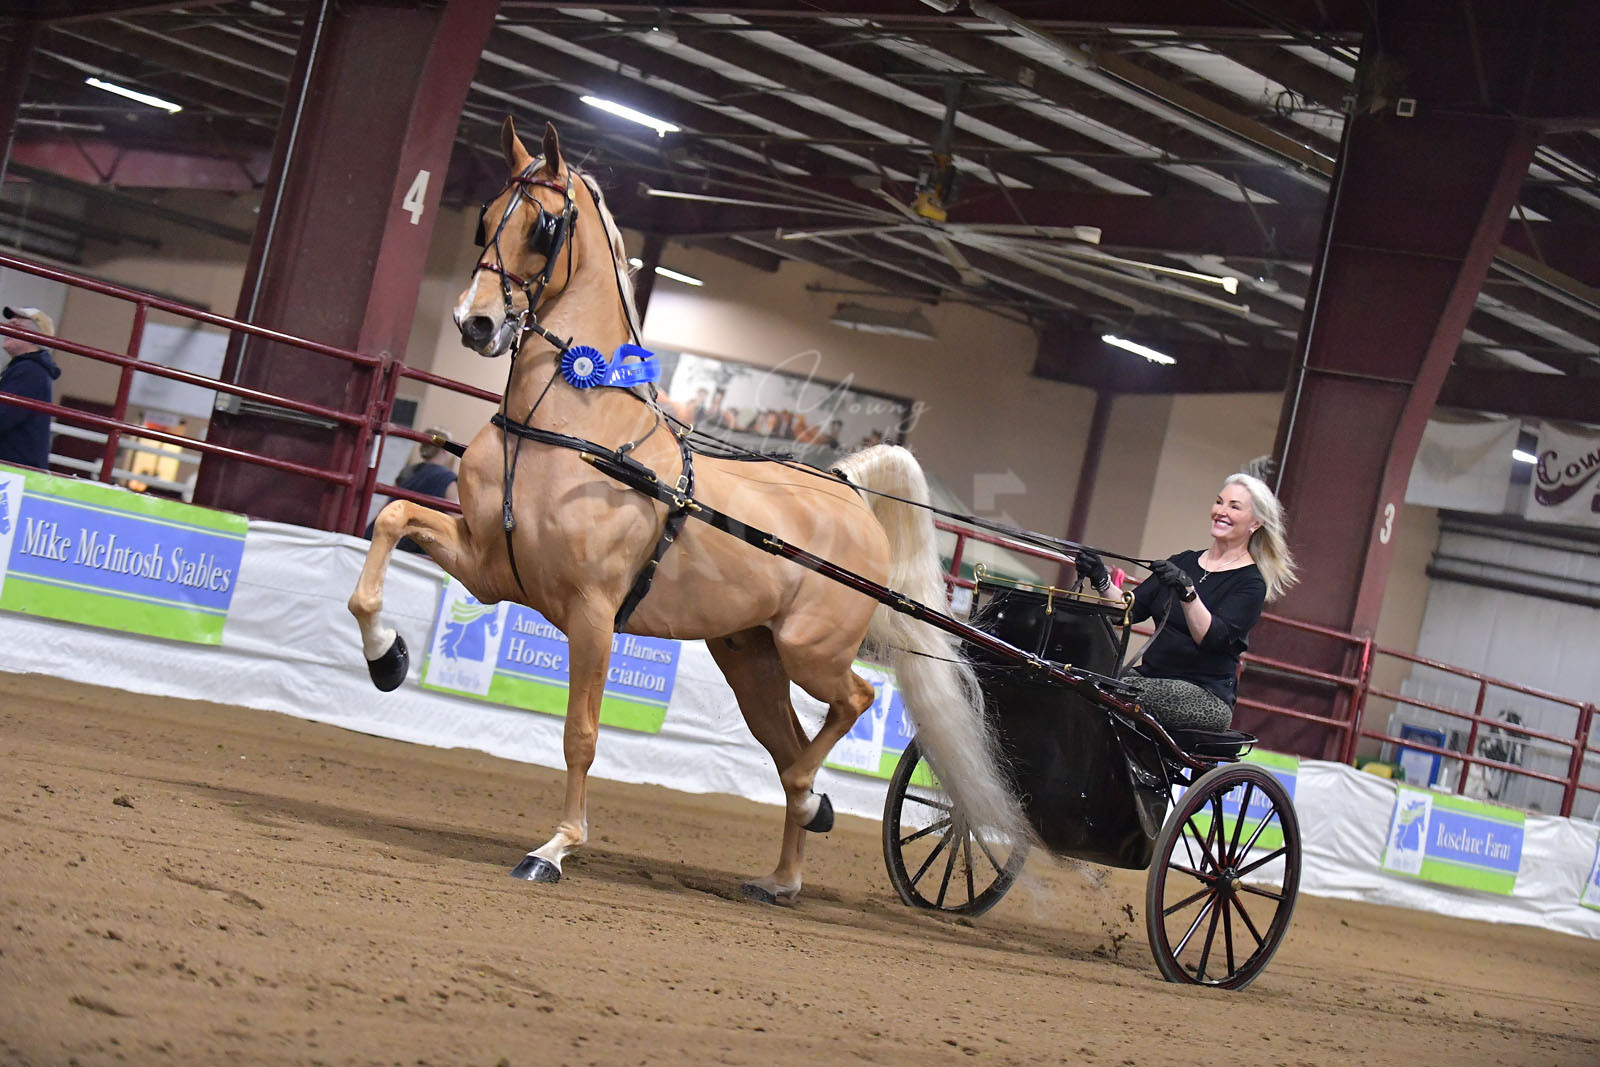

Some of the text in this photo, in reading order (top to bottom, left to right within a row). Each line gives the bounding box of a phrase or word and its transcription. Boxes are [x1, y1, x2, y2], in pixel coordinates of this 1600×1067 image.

[402, 169, 431, 225] 4
[1380, 502, 1396, 545] 3
[20, 517, 232, 593] Mike McIntosh Stables
[506, 637, 563, 671] Horse
[622, 637, 673, 665] Harness
[1484, 832, 1511, 860] Farm
